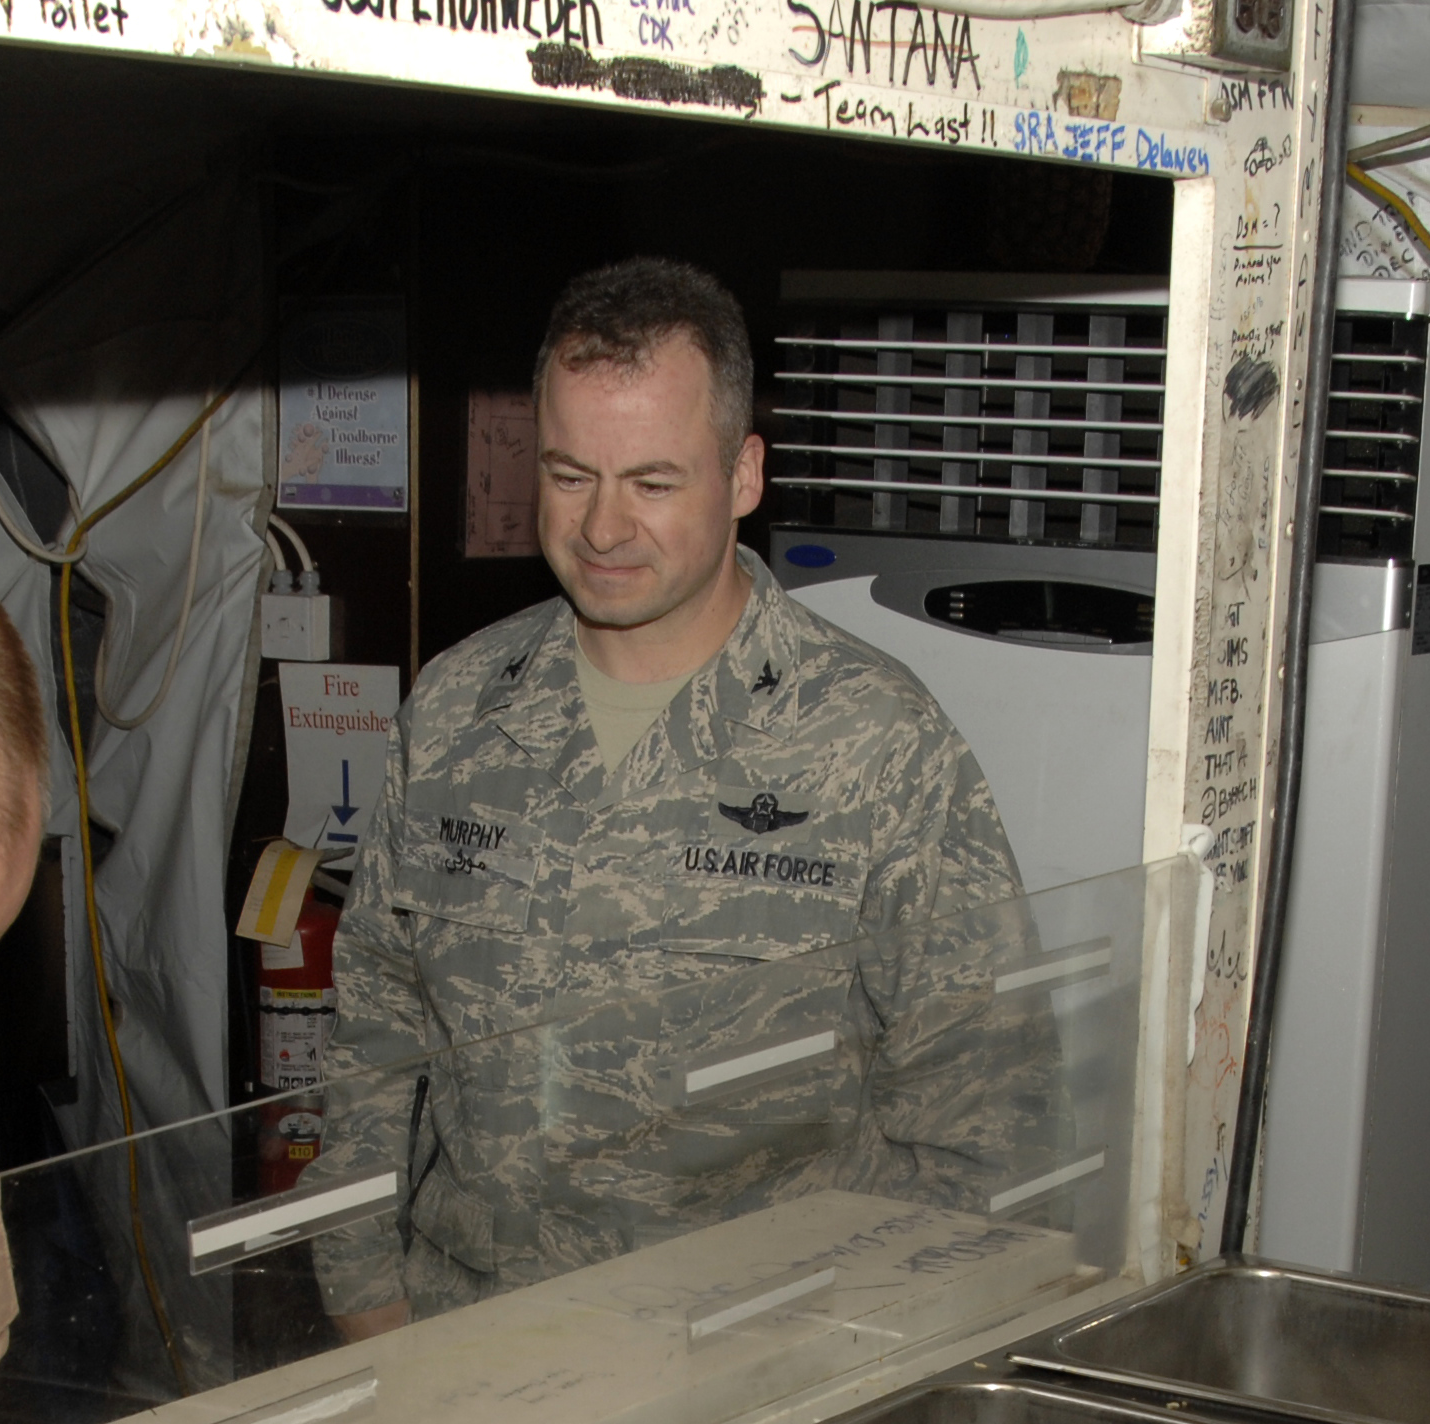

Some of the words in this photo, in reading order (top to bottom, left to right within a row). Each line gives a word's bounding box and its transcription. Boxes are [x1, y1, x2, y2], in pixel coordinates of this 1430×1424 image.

[327, 384, 377, 402] Defense
[314, 404, 358, 423] Against
[331, 428, 398, 445] Foodborne
[335, 448, 381, 465] Illness!
[322, 674, 360, 698] Fire
[439, 816, 507, 850] MURPHY
[685, 846, 719, 873] U.S.
[721, 850, 760, 877] AIR
[763, 853, 836, 887] FORCE
